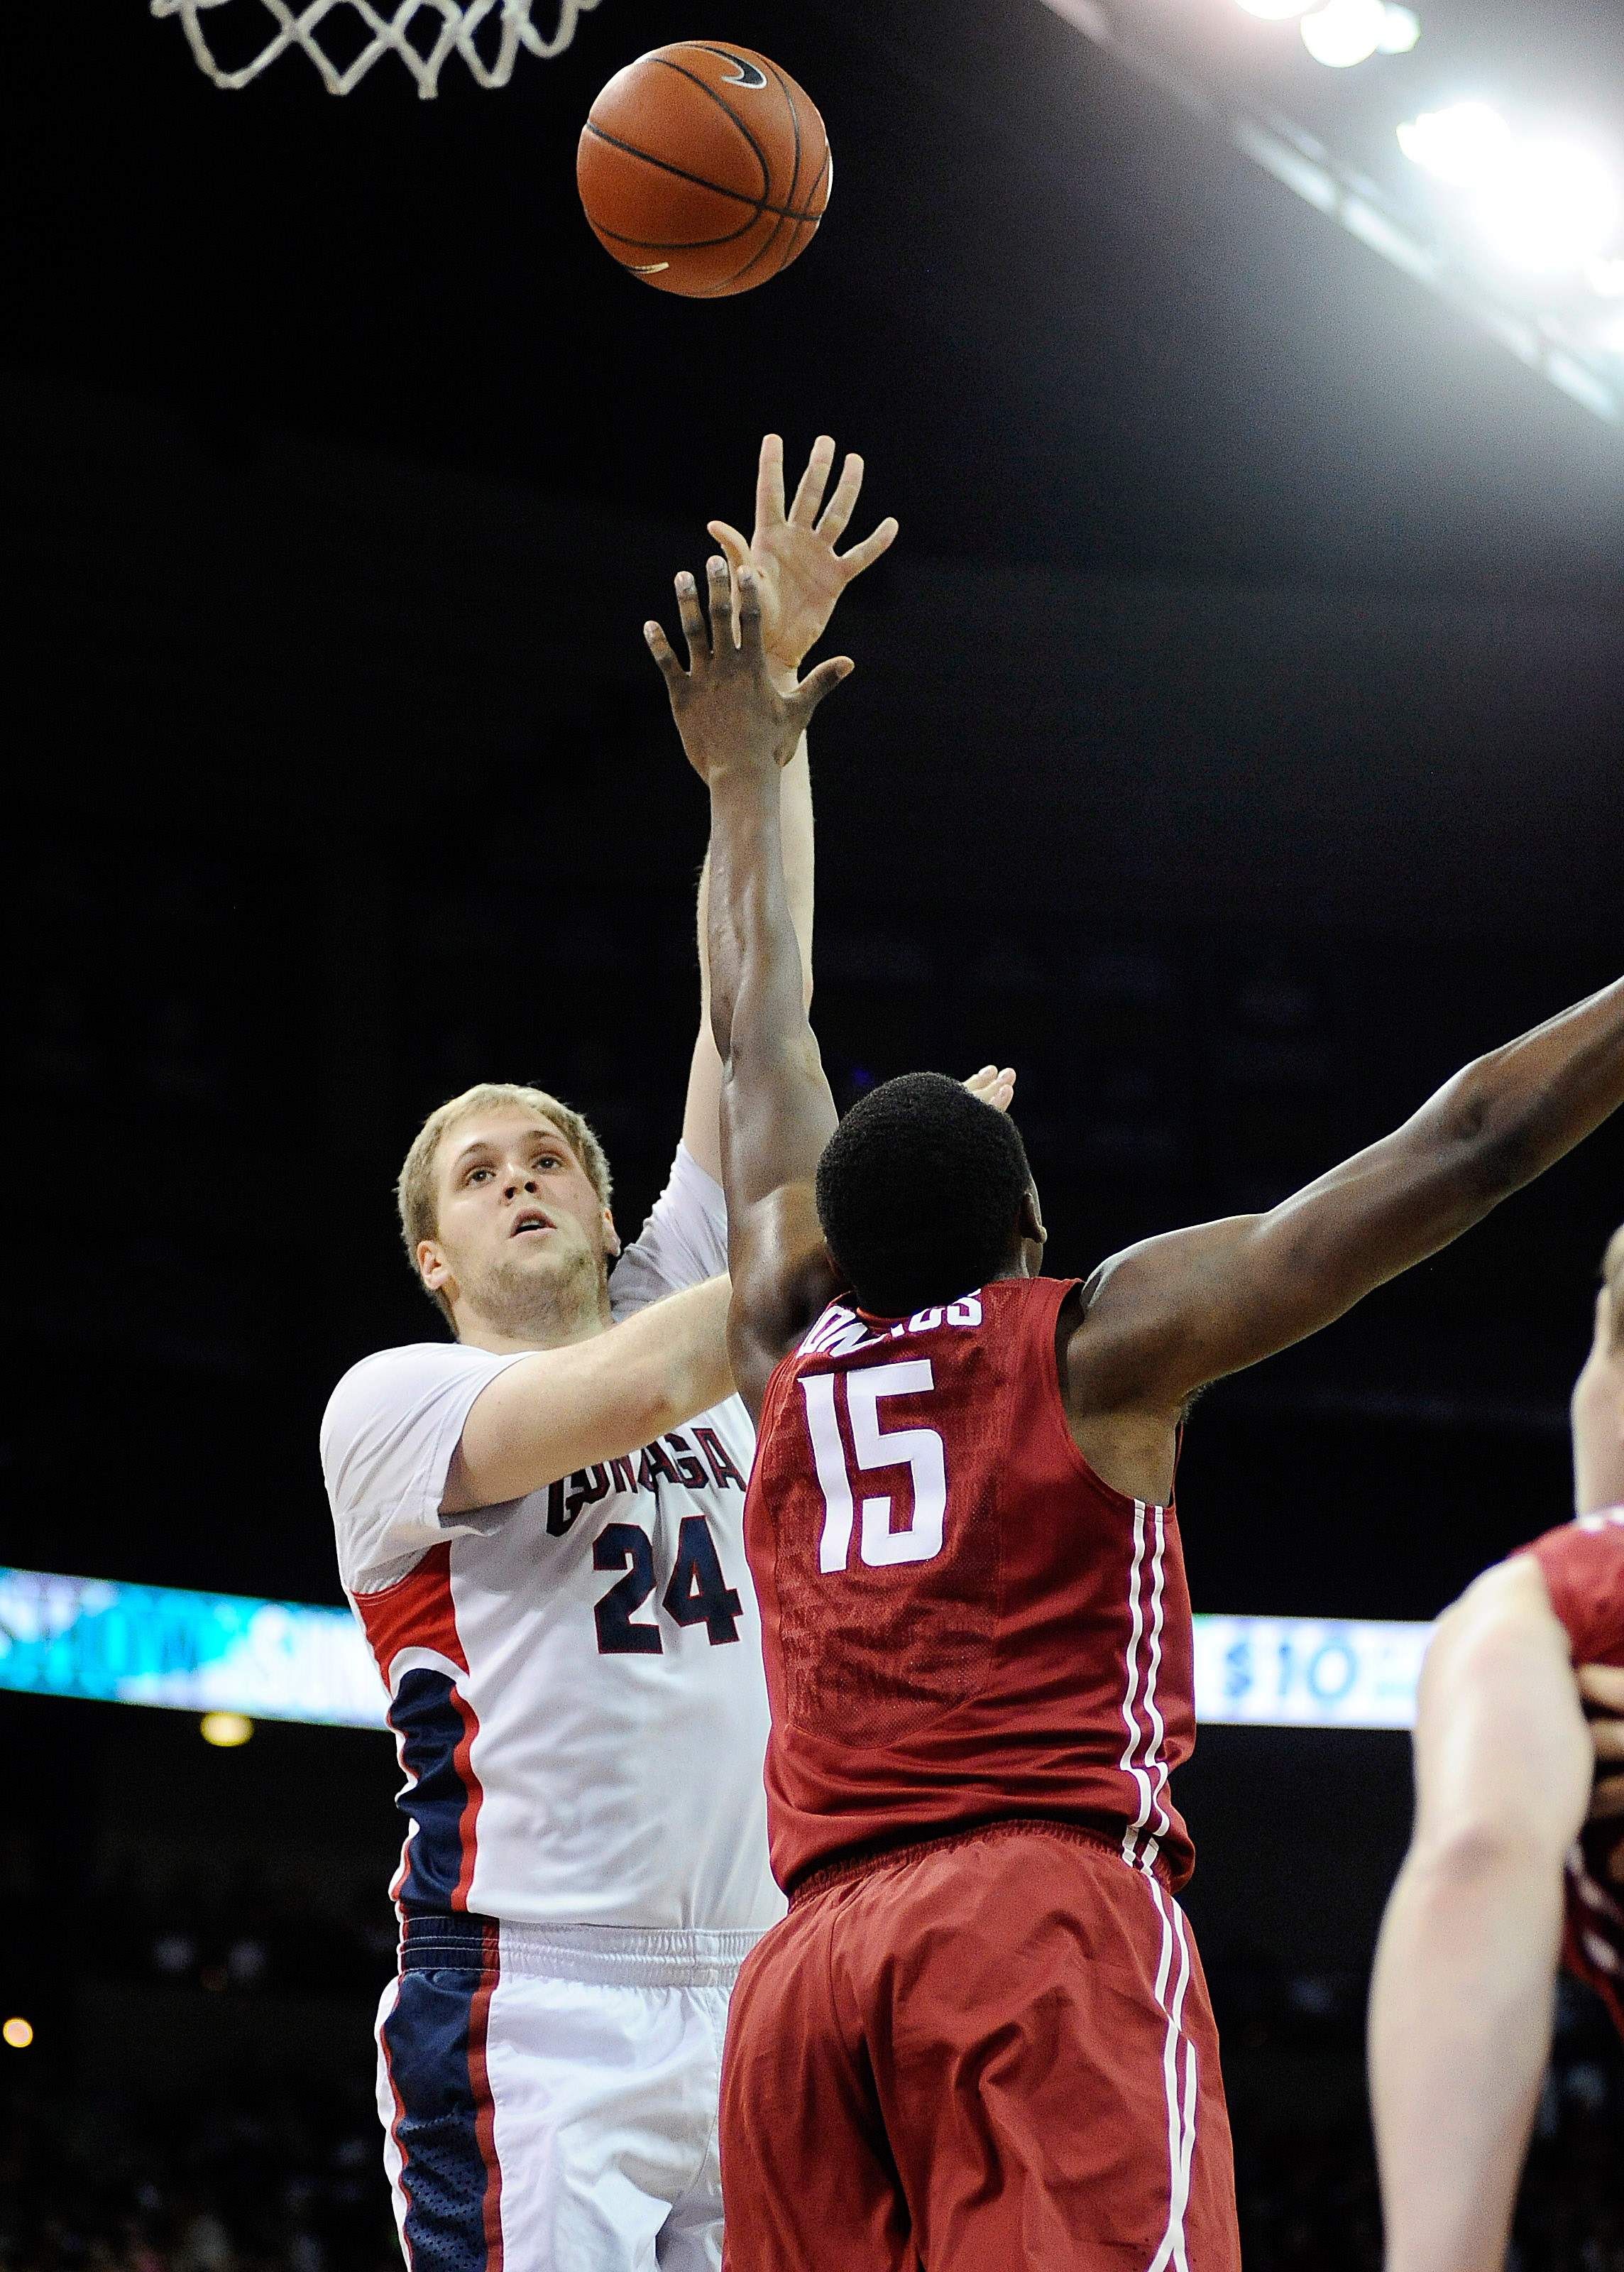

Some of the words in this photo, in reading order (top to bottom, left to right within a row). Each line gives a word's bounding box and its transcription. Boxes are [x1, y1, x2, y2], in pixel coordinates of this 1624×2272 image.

[546, 1428, 746, 1536] GONAGA
[797, 1359, 947, 1574] 15
[592, 1515, 743, 1654] 24
[1224, 1637, 1359, 1704] $10
